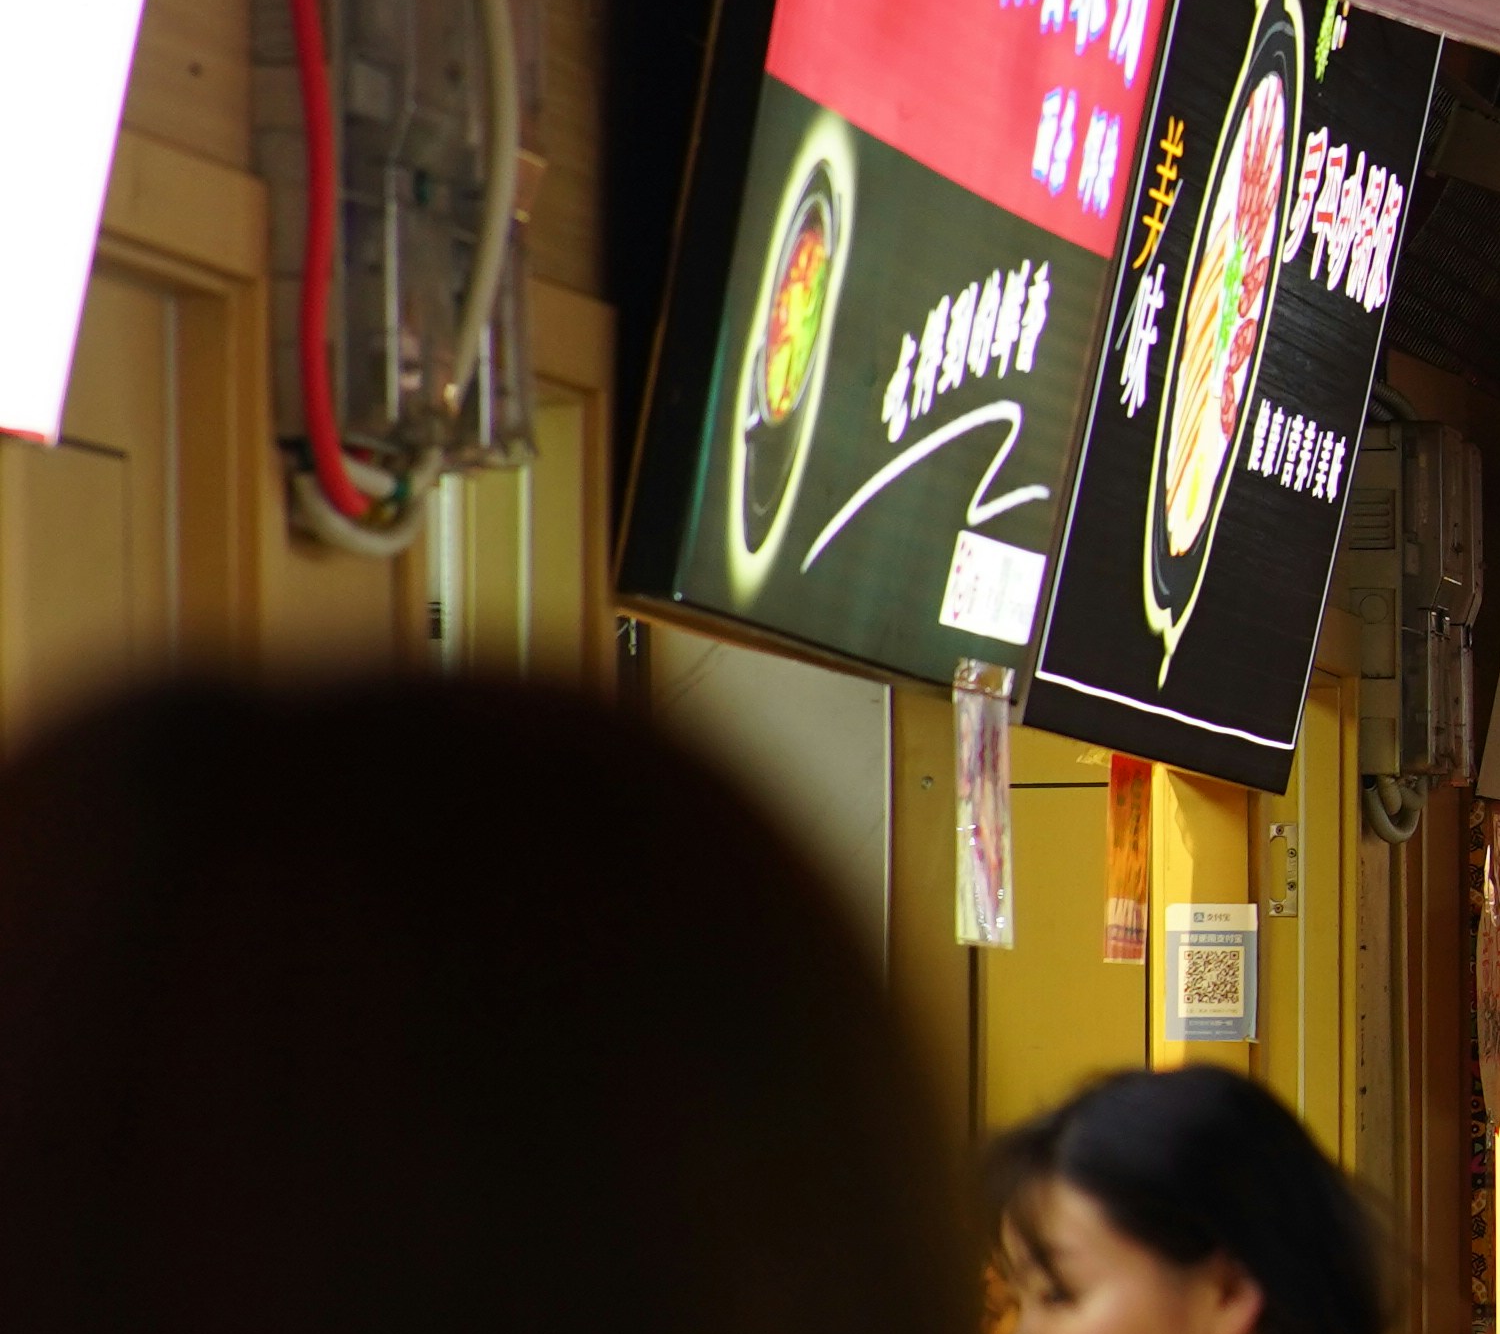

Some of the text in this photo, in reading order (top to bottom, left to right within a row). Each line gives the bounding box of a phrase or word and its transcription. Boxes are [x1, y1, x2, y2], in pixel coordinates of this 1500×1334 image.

[1282, 124, 1405, 315] 罗平砂锅饭
[881, 258, 1050, 444] 吃得到的鲜香
[1247, 396, 1347, 504] 健康/营养/美味
